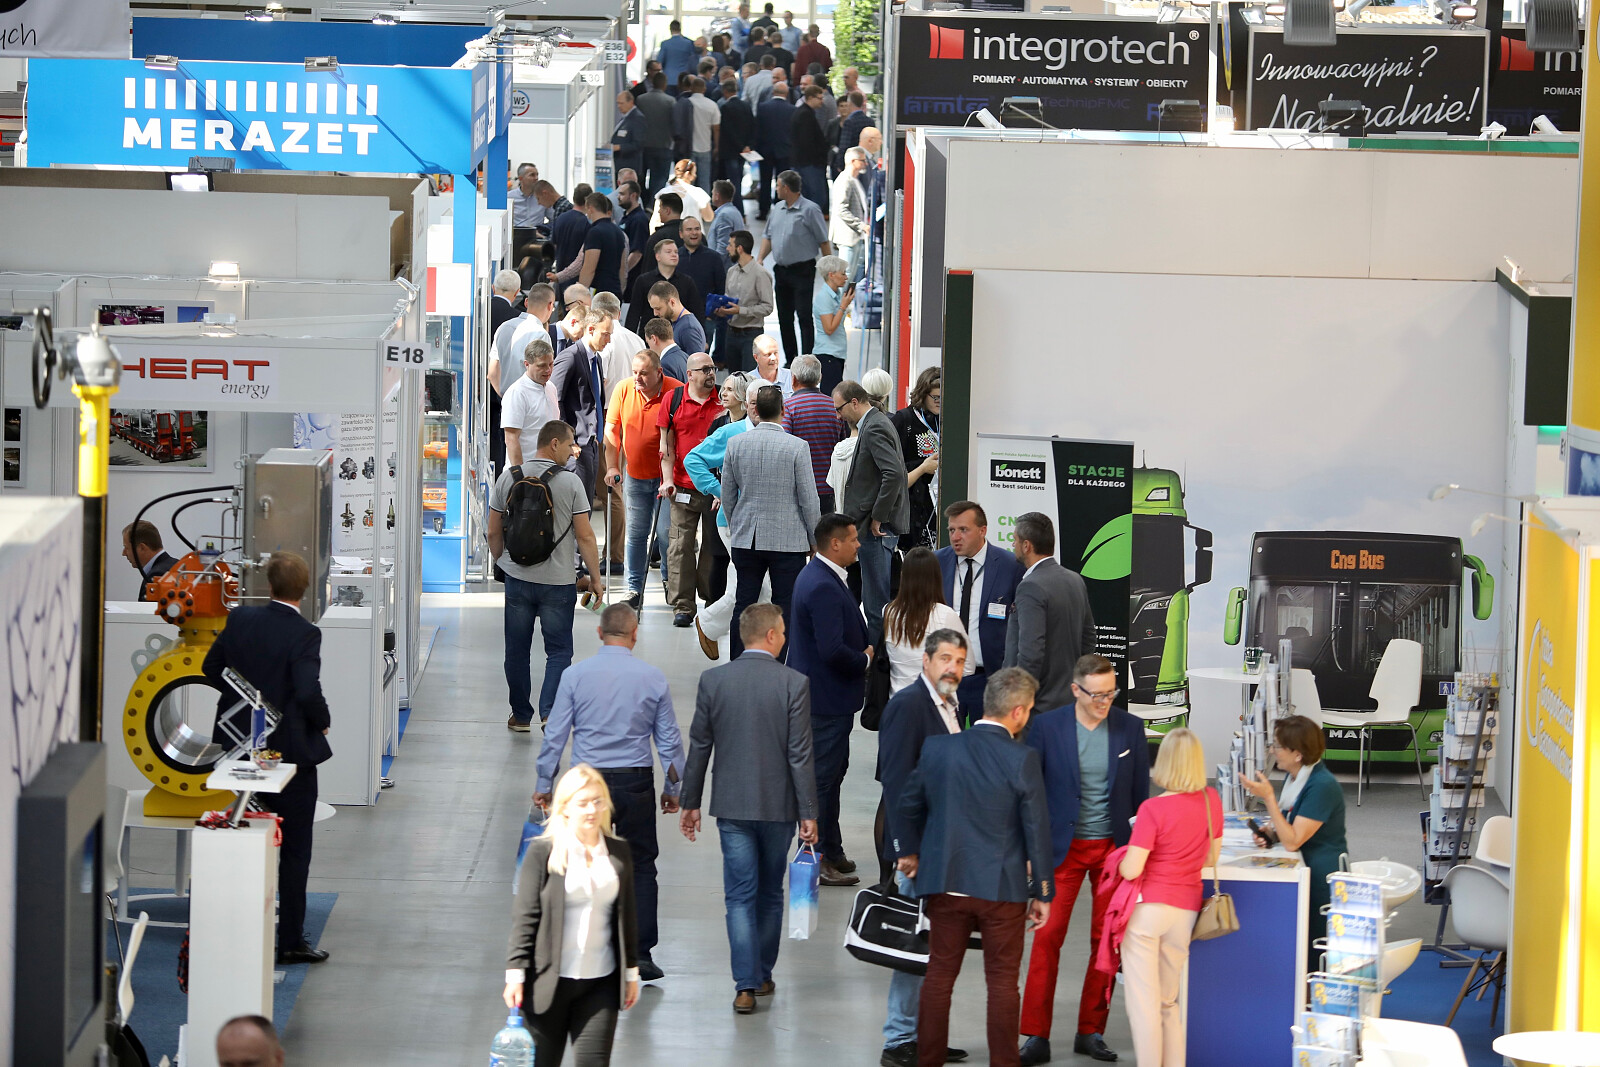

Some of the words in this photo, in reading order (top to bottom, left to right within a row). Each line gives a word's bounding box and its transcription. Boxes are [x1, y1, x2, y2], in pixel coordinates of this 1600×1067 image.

[606, 52, 625, 61] E32
[1255, 45, 1439, 88] Innowacyjni?
[972, 74, 1017, 85] POMIARY
[1022, 76, 1088, 86] AUTOMATYKA
[1094, 77, 1139, 88] SYSTEMY
[1146, 79, 1188, 89] OBIEKTY
[122, 117, 379, 156] MERAZET
[386, 345, 424, 364] E18
[221, 380, 270, 399] energy
[995, 464, 1041, 480] bonett
[1068, 464, 1125, 478] STACJE
[1086, 479, 1126, 488] KAŻDEGO
[998, 516, 1017, 526] CN
[1331, 549, 1356, 569] Cng
[1359, 549, 1385, 569] Bus
[1329, 729, 1373, 739] MAN
